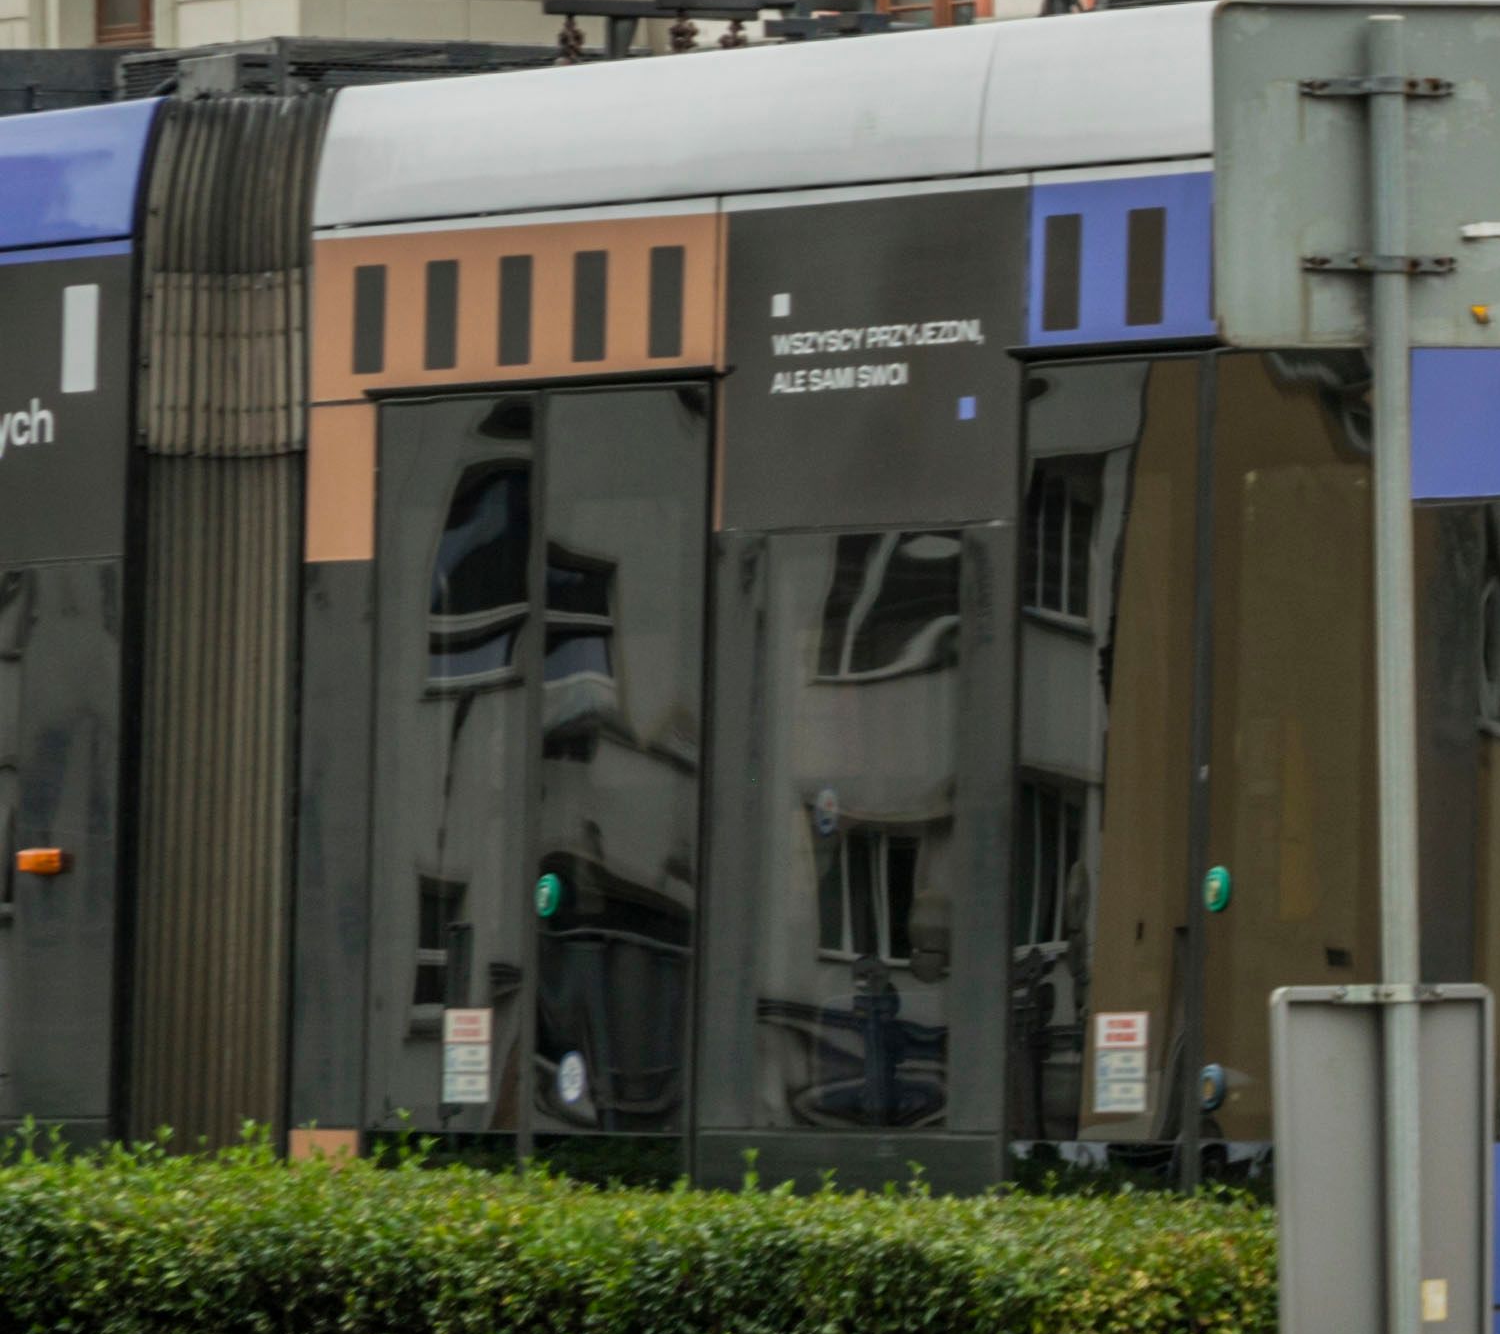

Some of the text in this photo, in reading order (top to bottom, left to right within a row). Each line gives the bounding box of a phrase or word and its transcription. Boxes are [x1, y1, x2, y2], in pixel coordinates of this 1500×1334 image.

[771, 319, 985, 356] WSZYSCY PRZYJEZDNI,
[769, 363, 909, 394] ALE SAMI SWOI
